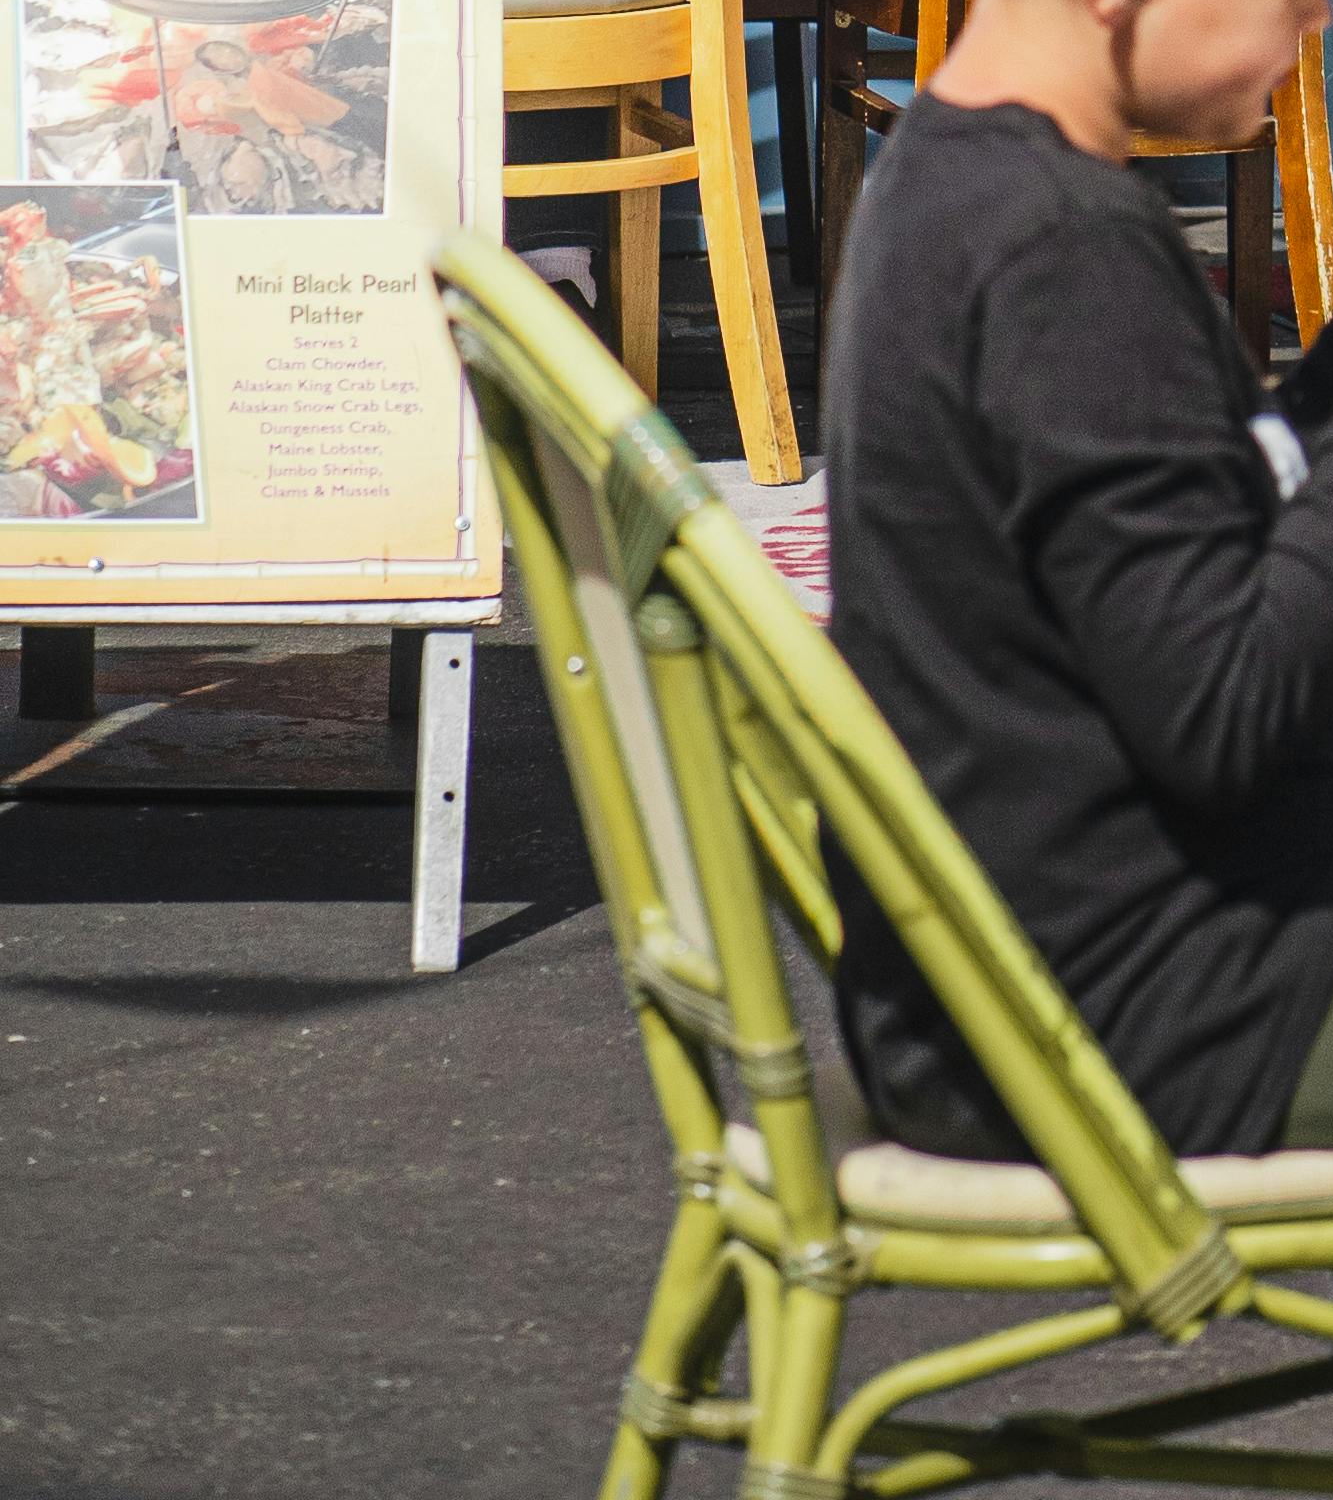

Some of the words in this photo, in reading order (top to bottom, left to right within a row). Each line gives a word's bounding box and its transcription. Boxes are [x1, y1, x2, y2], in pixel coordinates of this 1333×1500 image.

[236, 274, 283, 294] Mini
[293, 273, 352, 294] Black
[362, 273, 417, 294] Pearl
[290, 304, 364, 325] Platter
[294, 336, 344, 350] Serves
[351, 336, 359, 349] 2
[266, 357, 306, 371] Clam
[232, 379, 292, 392] Alaskan
[299, 379, 333, 395] King
[338, 379, 375, 392] Crab
[229, 401, 288, 413] Alaskan
[294, 400, 335, 413] Snow
[341, 400, 379, 413] Crab
[260, 421, 344, 437] Dungeness
[269, 443, 315, 456] Maine
[268, 464, 318, 480] Jumbo
[261, 485, 308, 498] Clams
[314, 485, 325, 497] &
[331, 484, 391, 498] Mussels
